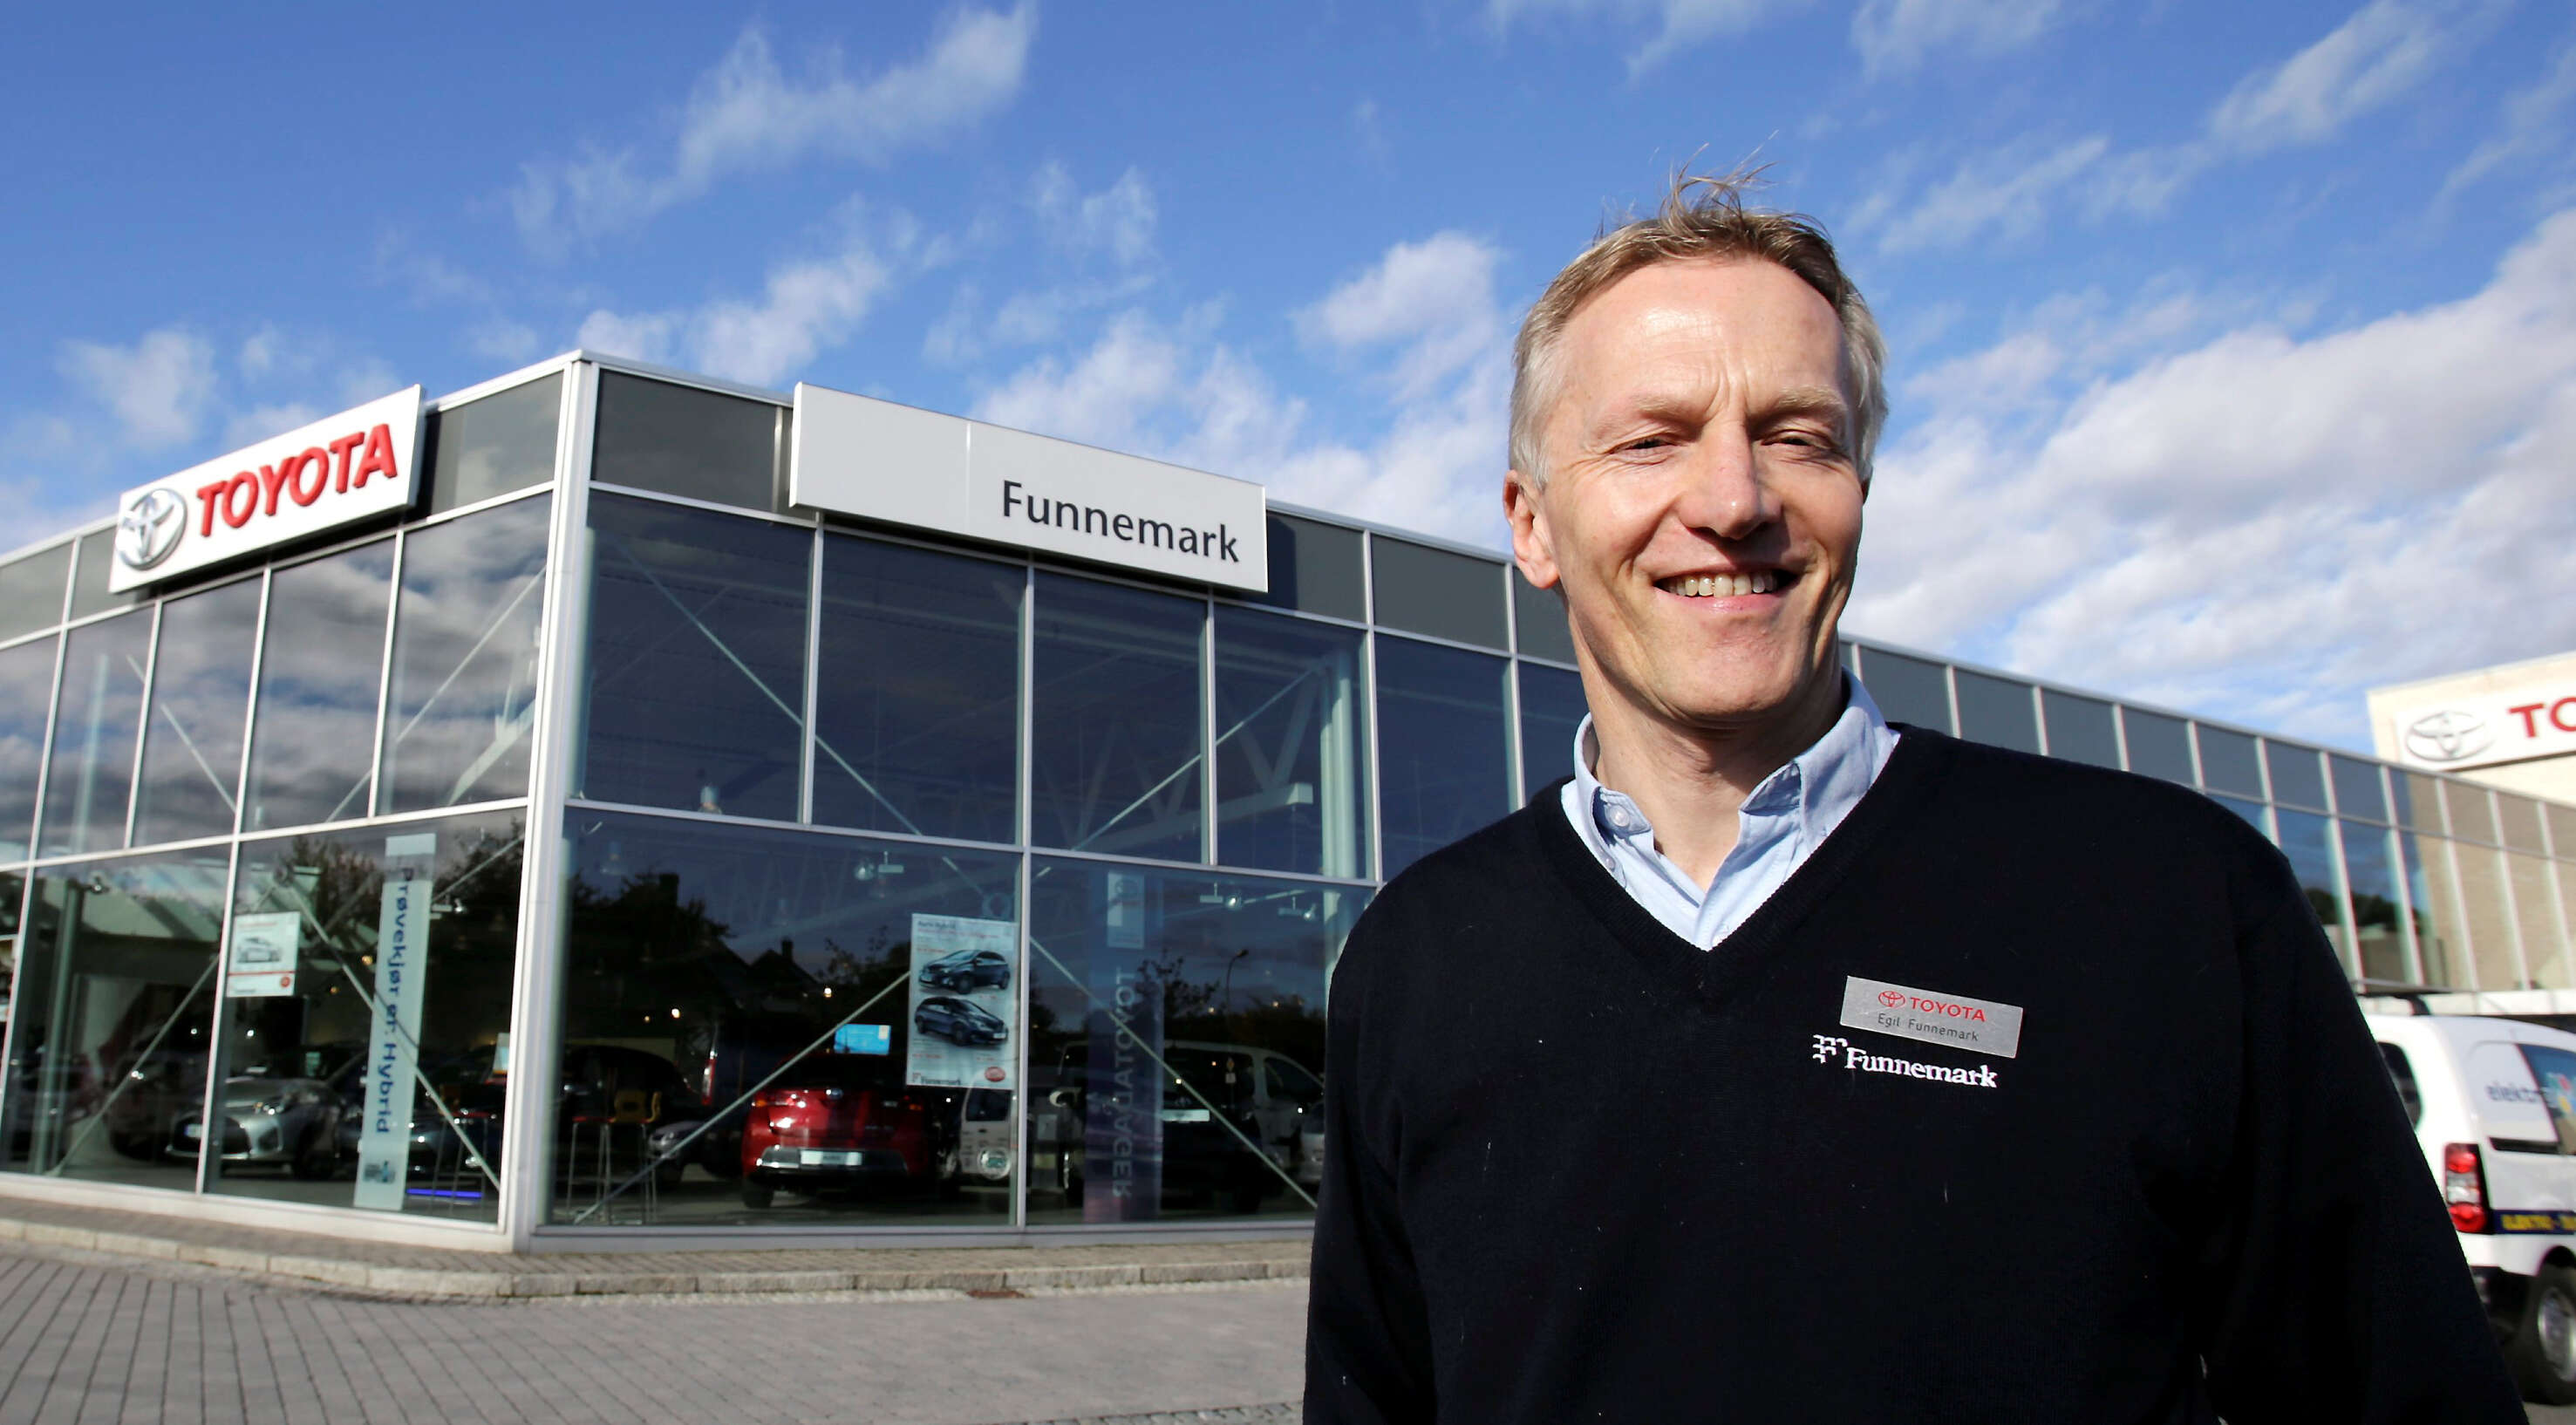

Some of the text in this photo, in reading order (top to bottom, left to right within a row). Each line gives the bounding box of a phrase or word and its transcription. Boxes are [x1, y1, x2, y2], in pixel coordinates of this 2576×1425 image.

[197, 423, 399, 537] TOYOTA
[1003, 480, 1239, 562] Funnemark
[1878, 1013, 1980, 1042] Egil Funnemark
[1910, 997, 1987, 1022] TOYOTA
[376, 1043, 397, 1133] Hybrid
[1844, 1047, 1999, 1088] Funnemark
